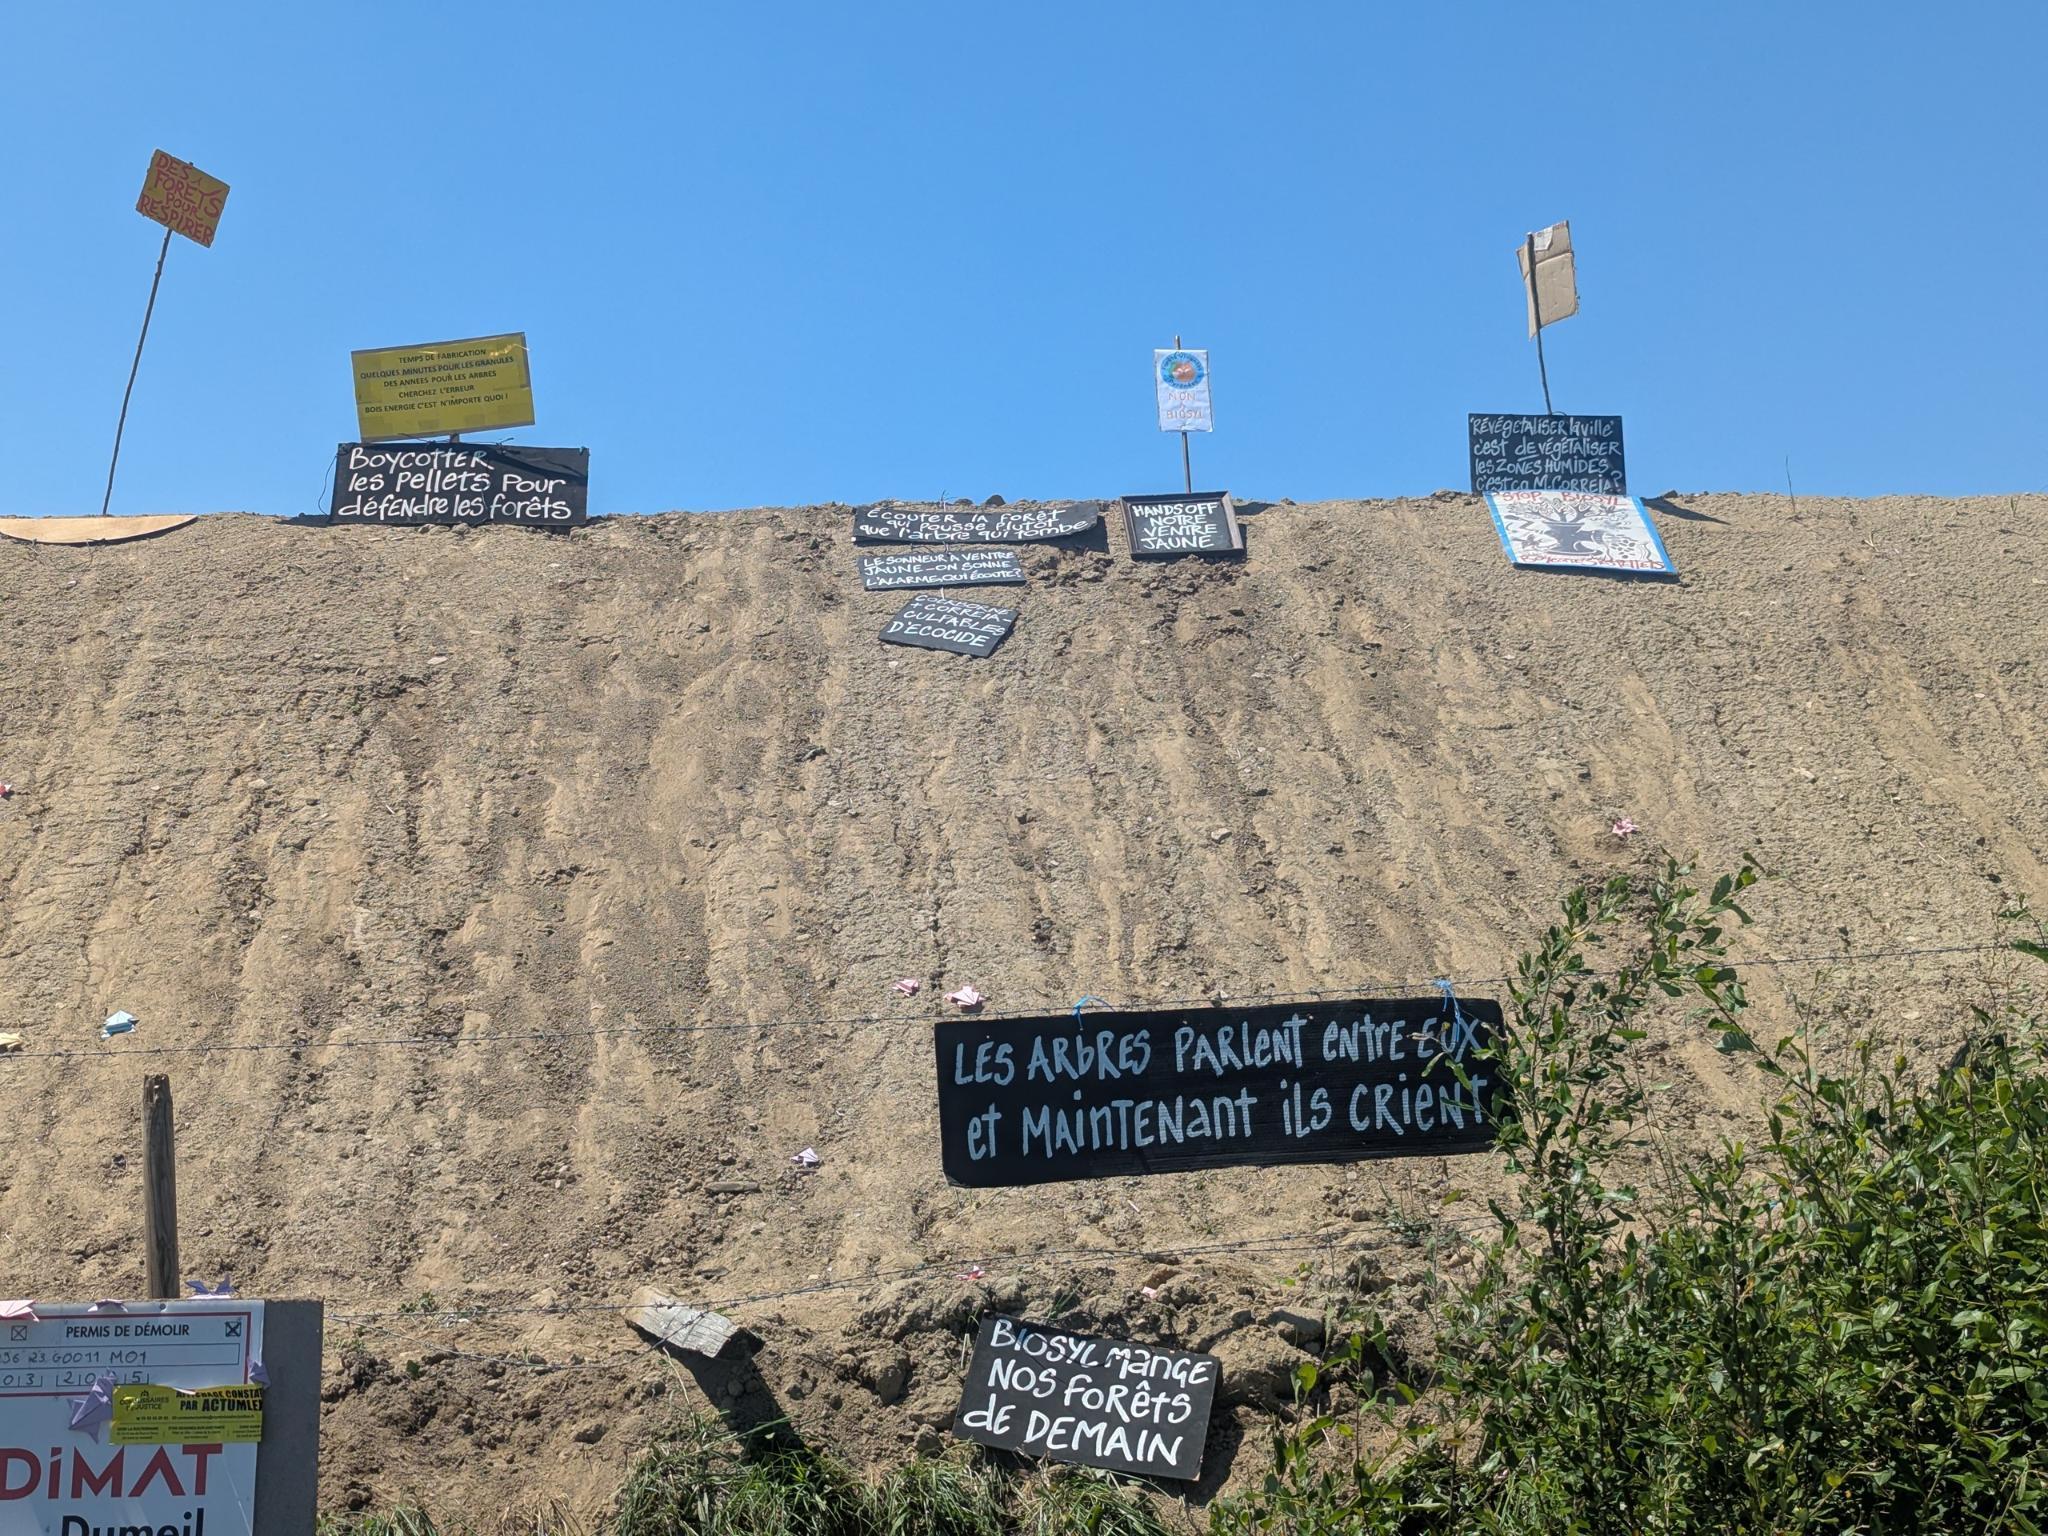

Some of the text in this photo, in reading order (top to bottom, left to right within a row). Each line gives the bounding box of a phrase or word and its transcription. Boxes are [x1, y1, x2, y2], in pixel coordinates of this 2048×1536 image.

[157, 154, 192, 180] DES
[399, 355, 424, 364] TEMPS
[437, 349, 486, 359] FABRICATION
[360, 369, 400, 379] QUELQUES
[402, 365, 437, 375] MINUTES
[438, 363, 461, 371] POUR
[475, 356, 514, 367] GRANULES
[431, 374, 453, 382] POUR
[468, 370, 497, 378] ARBRES
[398, 389, 436, 398] CHERCHEZ
[1168, 391, 1196, 401] NON
[417, 401, 437, 409] C'EST
[348, 472, 385, 492] les
[1503, 491, 1542, 501] STOP
[452, 494, 484, 517] les
[490, 493, 572, 519] forêts
[1132, 502, 1218, 518] HANDS OFF
[886, 519, 910, 529] qui
[1149, 513, 1208, 527] NOTRE
[860, 524, 890, 536] que
[978, 529, 1009, 540] qui
[1143, 523, 1218, 538] VENTRE
[1140, 535, 1215, 550] JAUNE
[864, 557, 884, 568] LE
[885, 554, 948, 564] SONNEUR
[961, 551, 1015, 561] VENTRE
[864, 564, 923, 576] JAUNE
[962, 560, 1012, 571] SONNE
[903, 610, 1005, 636] CULPABLES
[954, 1040, 1015, 1086] LES
[1417, 1016, 1482, 1063] EUX
[967, 1102, 1002, 1161] et
[66, 1322, 190, 1338] PERMIS DE DÉMOLIR
[990, 1318, 1100, 1368] BIOSYL
[987, 1357, 1057, 1398] NOS
[180, 1400, 198, 1411] PAR
[1023, 1409, 1184, 1466] DEMAIN
